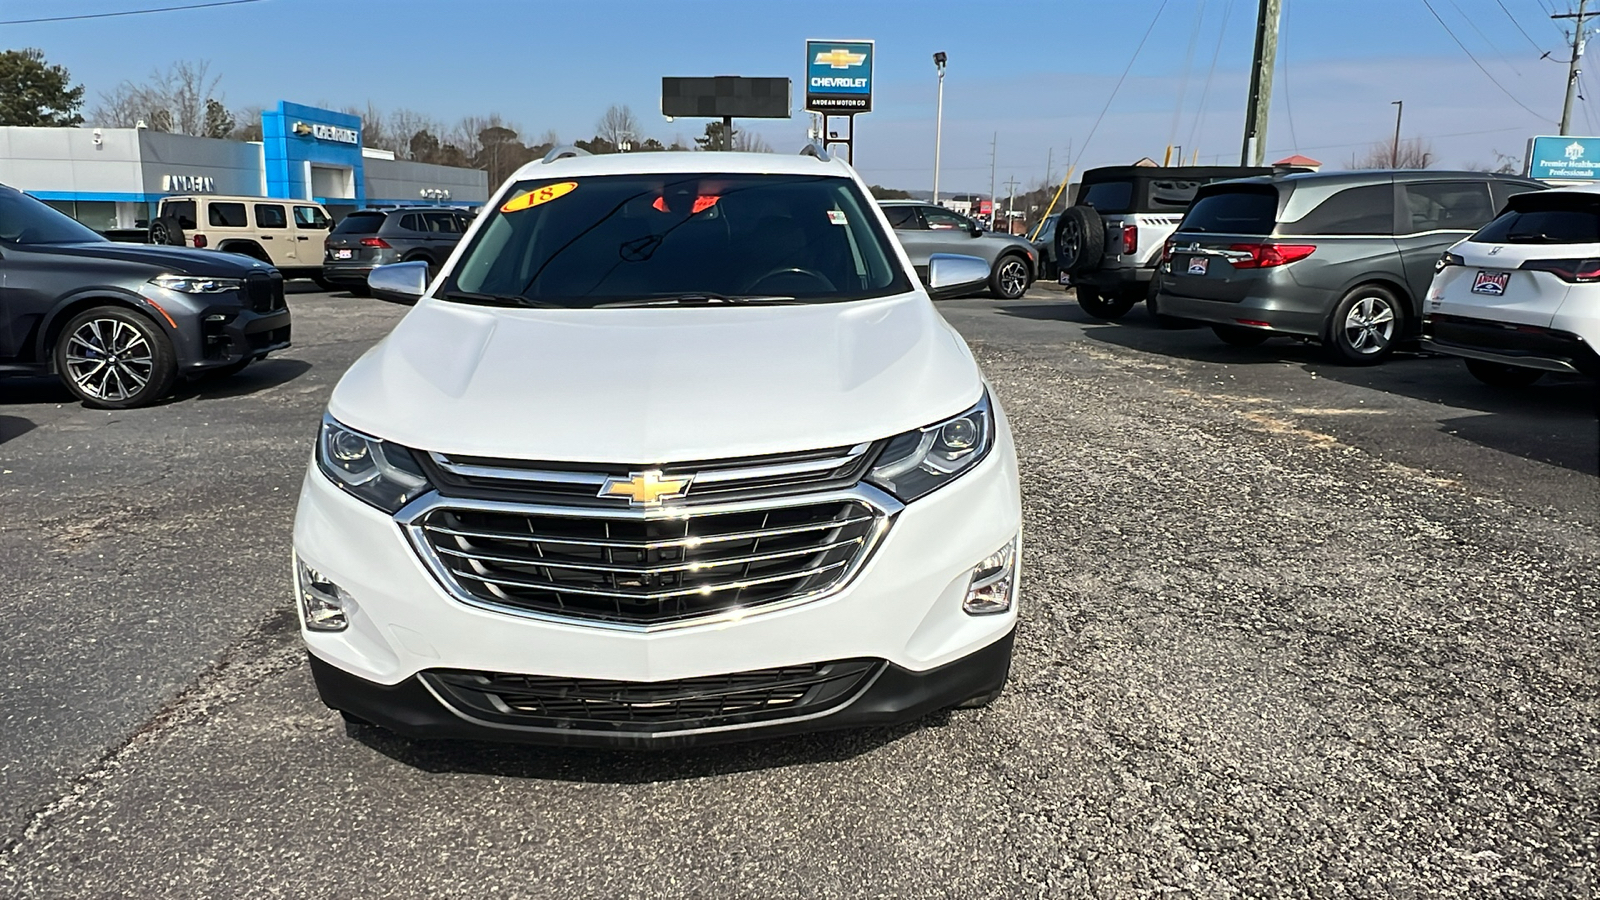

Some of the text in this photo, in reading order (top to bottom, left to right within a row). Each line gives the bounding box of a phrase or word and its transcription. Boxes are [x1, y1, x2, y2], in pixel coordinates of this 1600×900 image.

[811, 77, 867, 87] CHEVROLET
[836, 99, 857, 107] MOTOR
[1540, 160, 1568, 168] Premier
[163, 175, 214, 192] ANDEAN
[528, 187, 554, 206] 18
